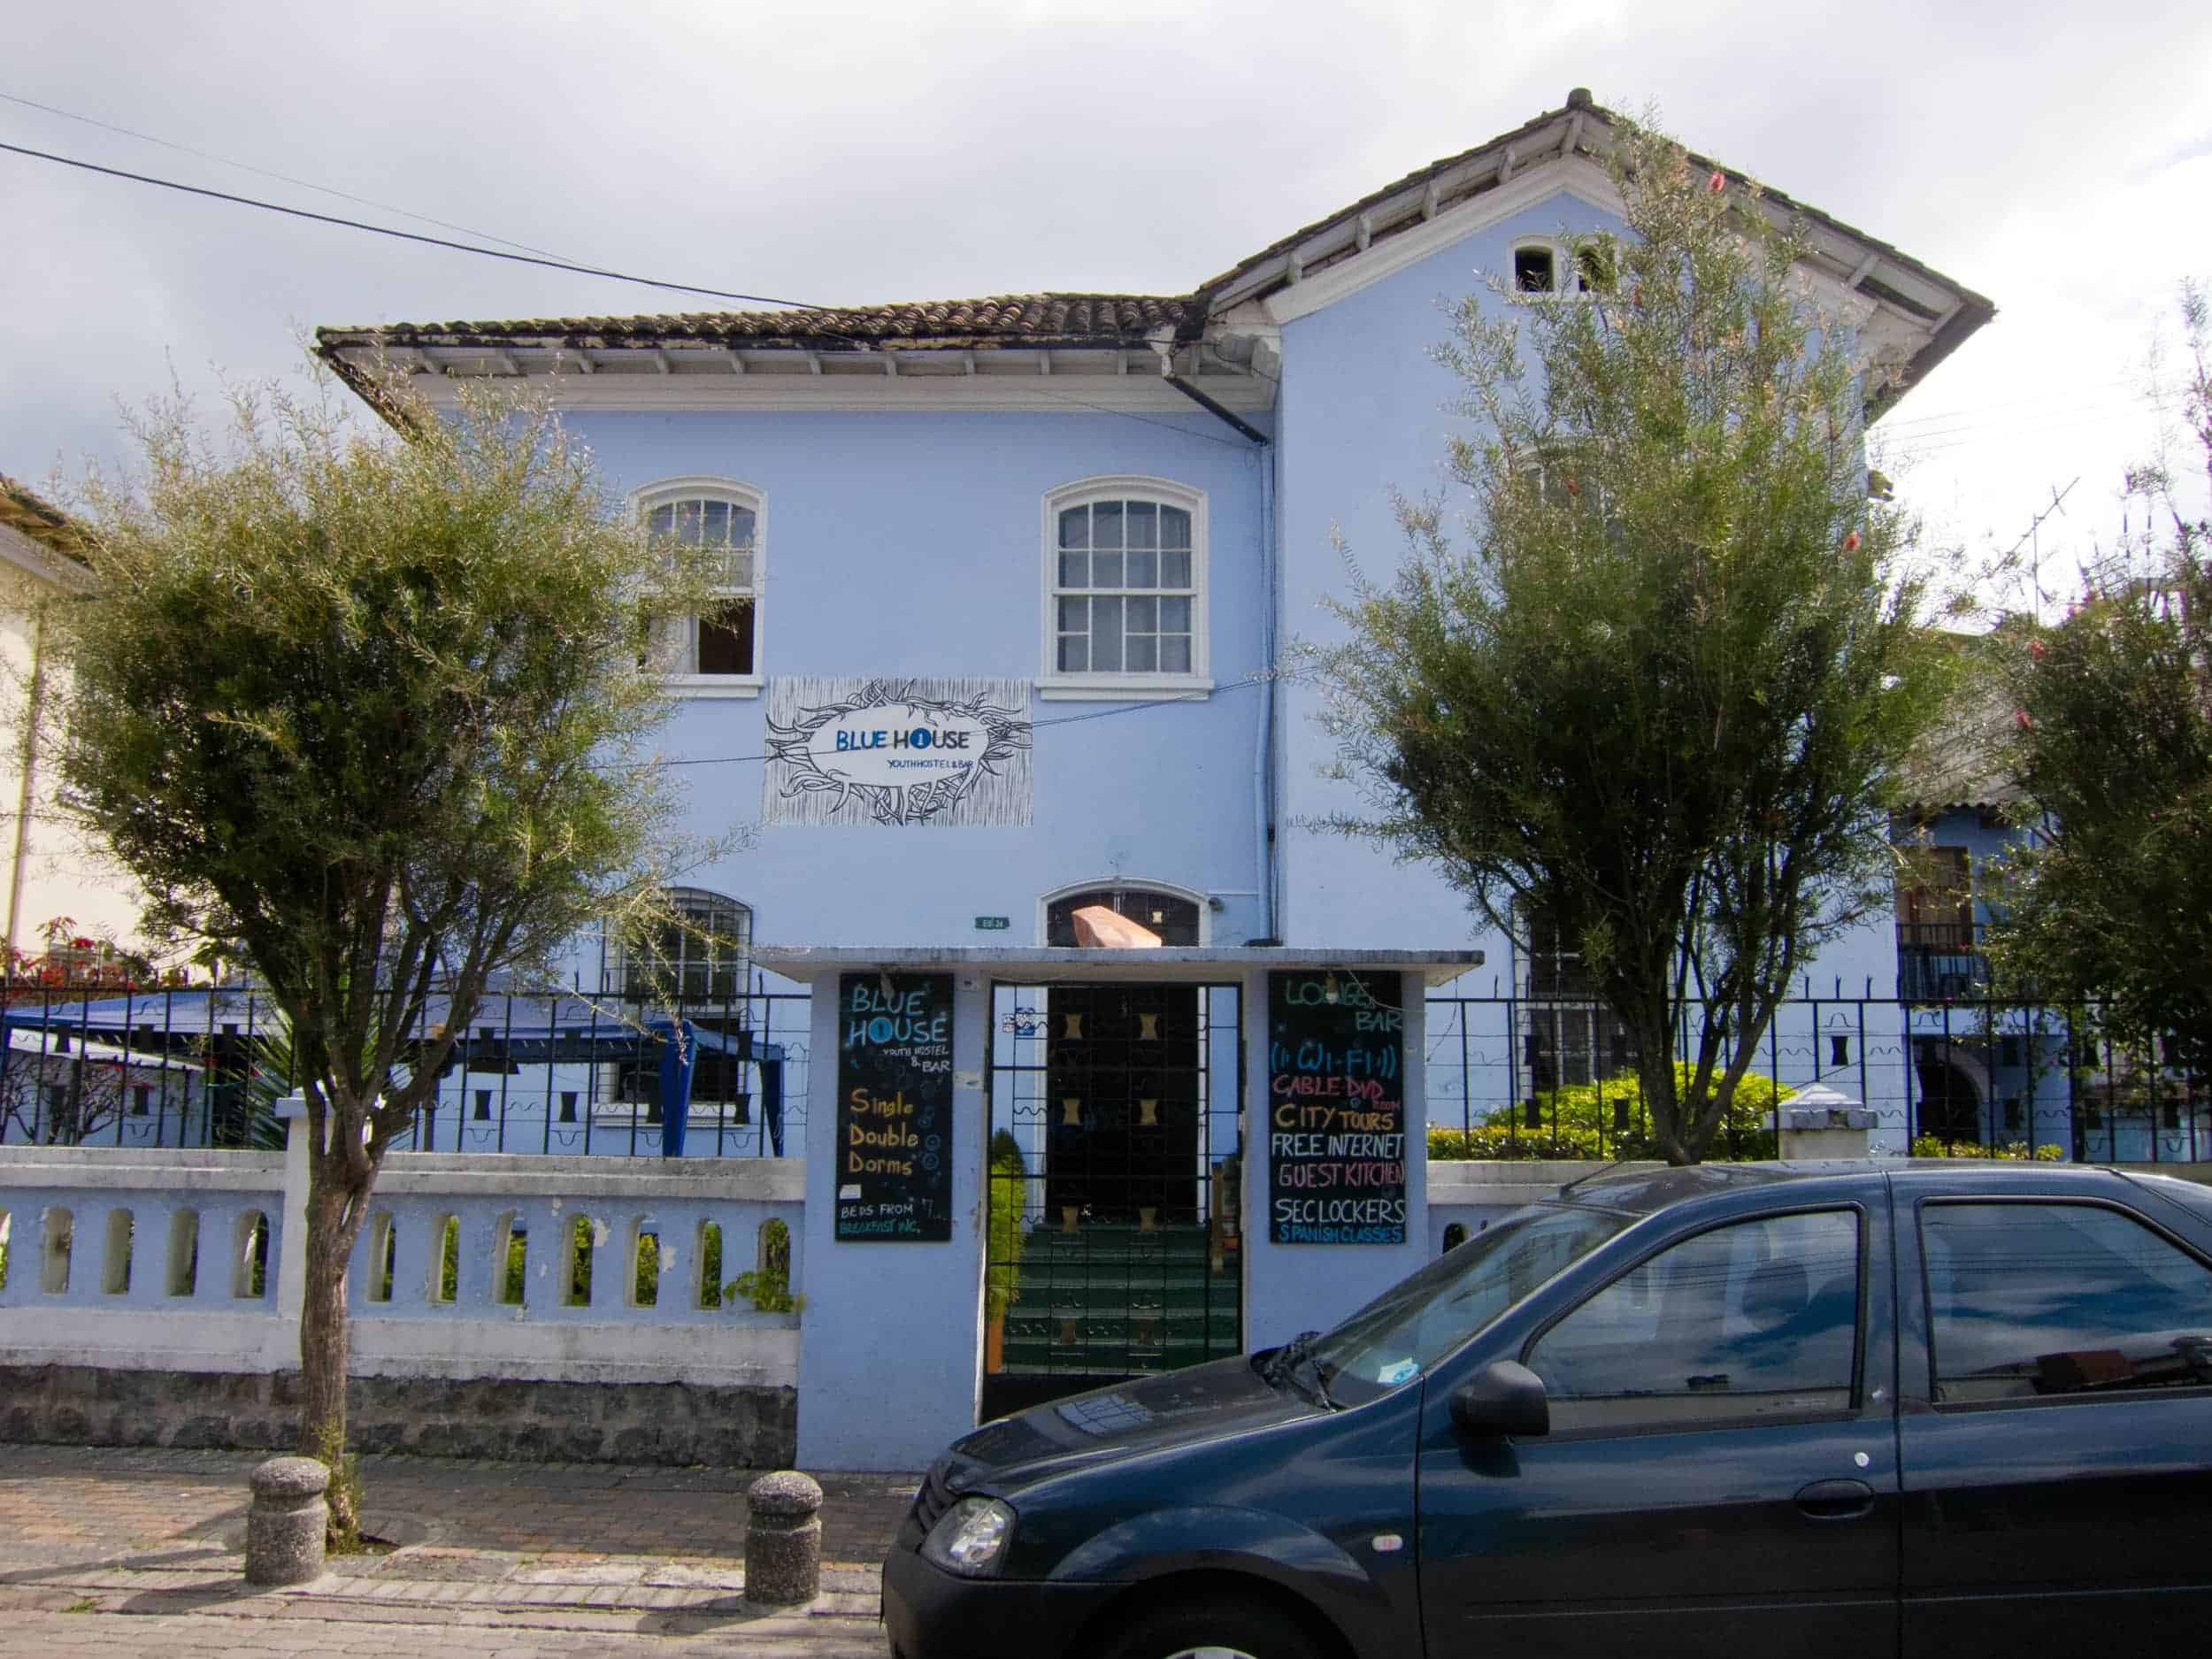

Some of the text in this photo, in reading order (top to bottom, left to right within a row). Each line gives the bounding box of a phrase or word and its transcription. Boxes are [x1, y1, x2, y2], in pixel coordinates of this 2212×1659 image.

[836, 727, 971, 751] BLUE HOUSE
[852, 984, 925, 1017] BLUE
[846, 1012, 949, 1048] HOUSE
[1356, 1011, 1403, 1033] BAR
[883, 1044, 949, 1056] YOUTH HOSTEL
[922, 1060, 951, 1073] BAR
[1272, 1075, 1384, 1099] CABLE DVD
[850, 1088, 914, 1117] Single
[1275, 1103, 1395, 1132] CITY TOURS
[849, 1121, 919, 1147] Double
[1271, 1133, 1404, 1159] FREE INTERNET
[849, 1150, 914, 1175] Dorms
[1279, 1160, 1405, 1187] GUEST KITCHEN
[841, 1204, 874, 1219] BEDS
[879, 1203, 914, 1216] FROM
[1279, 1224, 1402, 1243] SPANISH CLASSES
